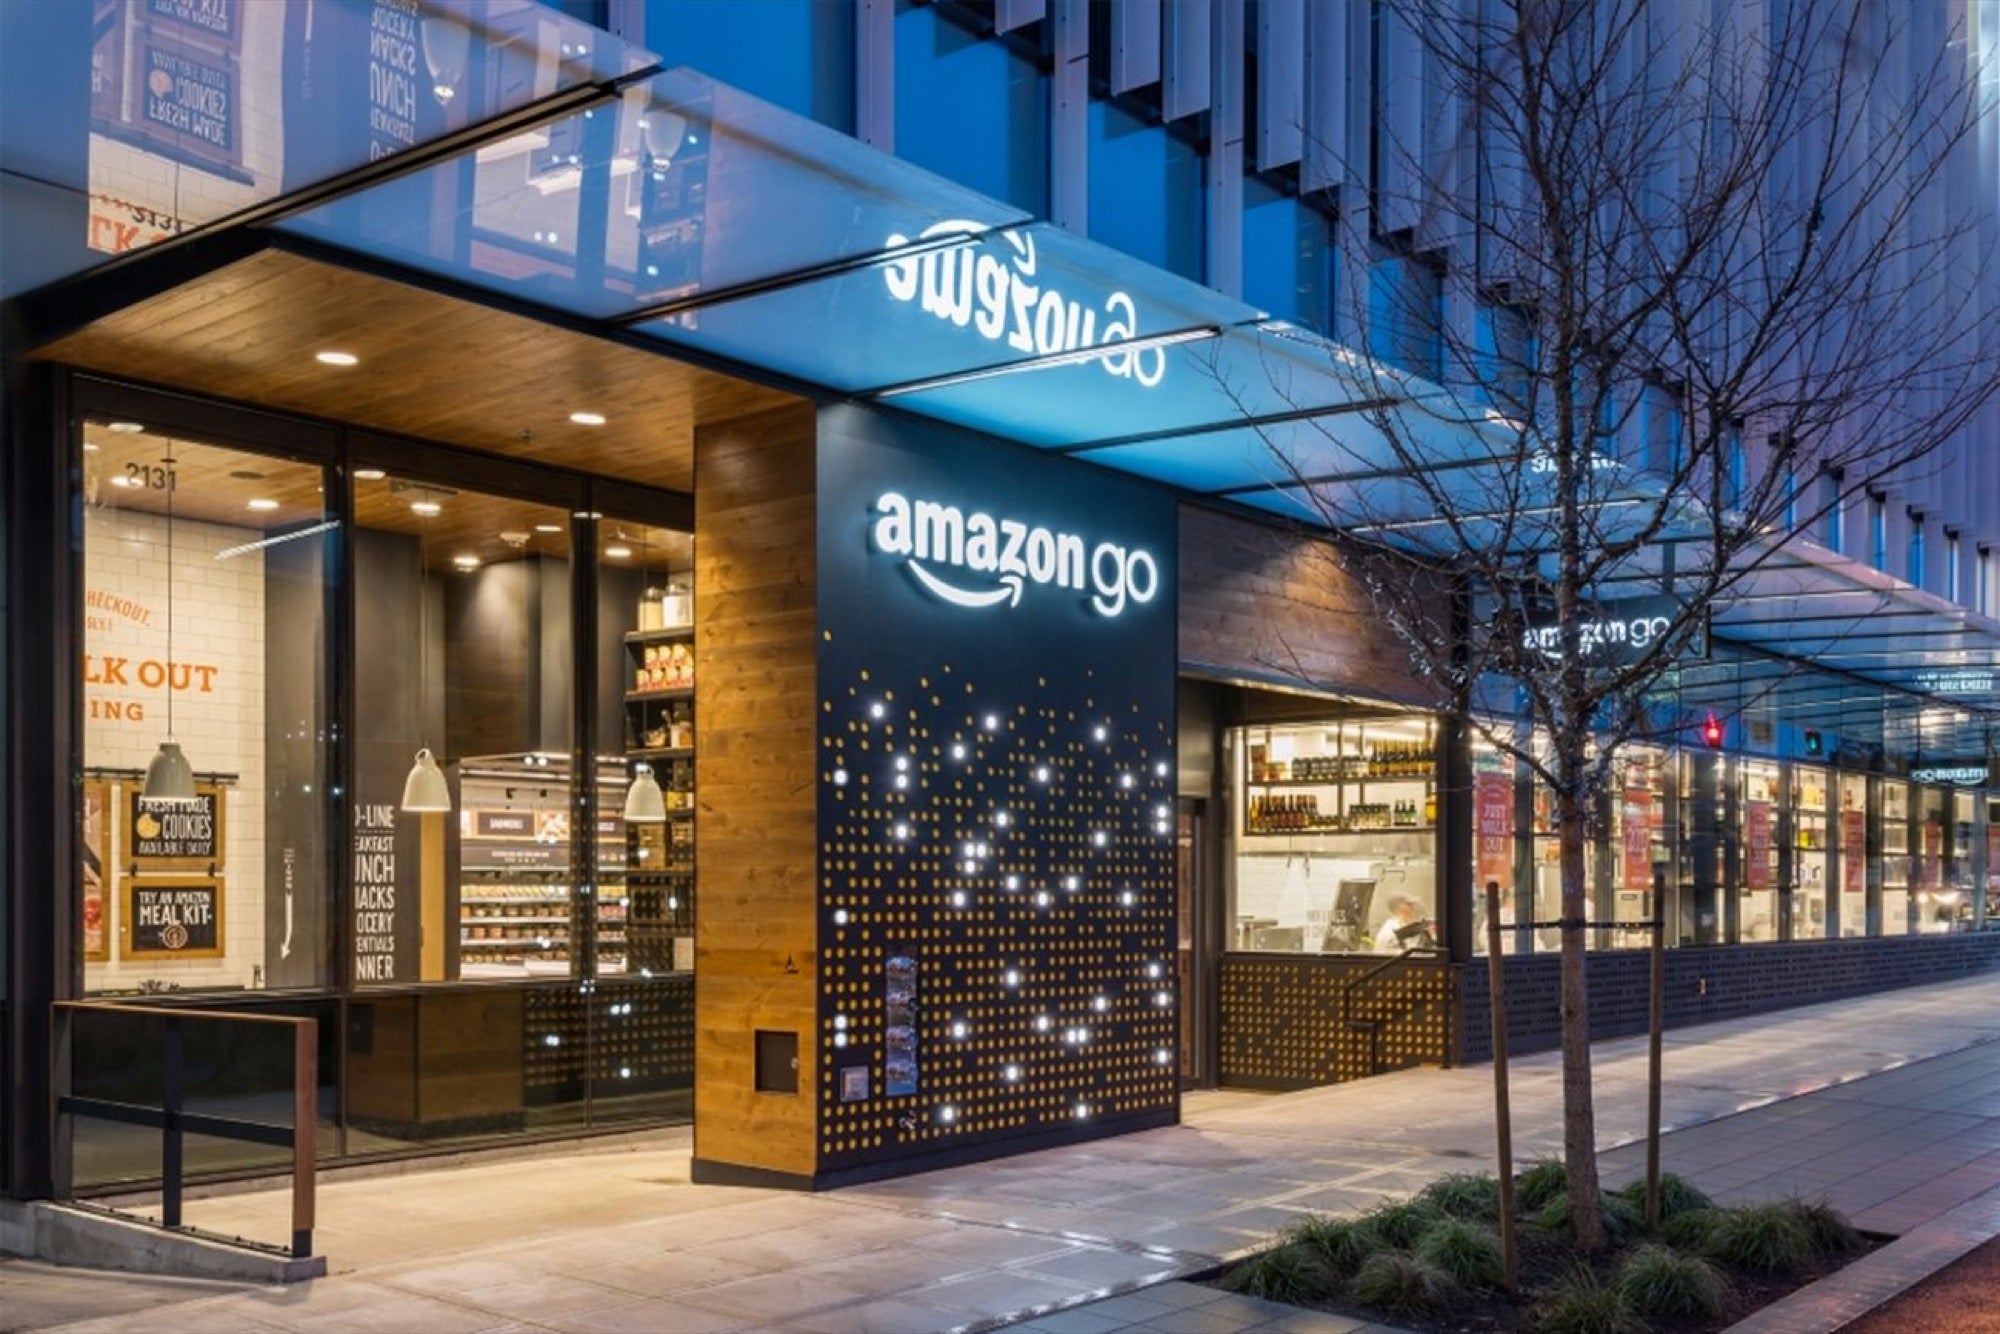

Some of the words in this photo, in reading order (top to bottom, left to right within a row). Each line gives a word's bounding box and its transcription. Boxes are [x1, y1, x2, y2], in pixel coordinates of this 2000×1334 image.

[125, 461, 177, 493] 2131
[875, 491, 1085, 592] amazon
[1091, 542, 1158, 618] go
[138, 660, 218, 692] OUT
[90, 700, 144, 721] ING
[162, 814, 212, 839] COOKIES
[139, 905, 181, 926] MEAL
